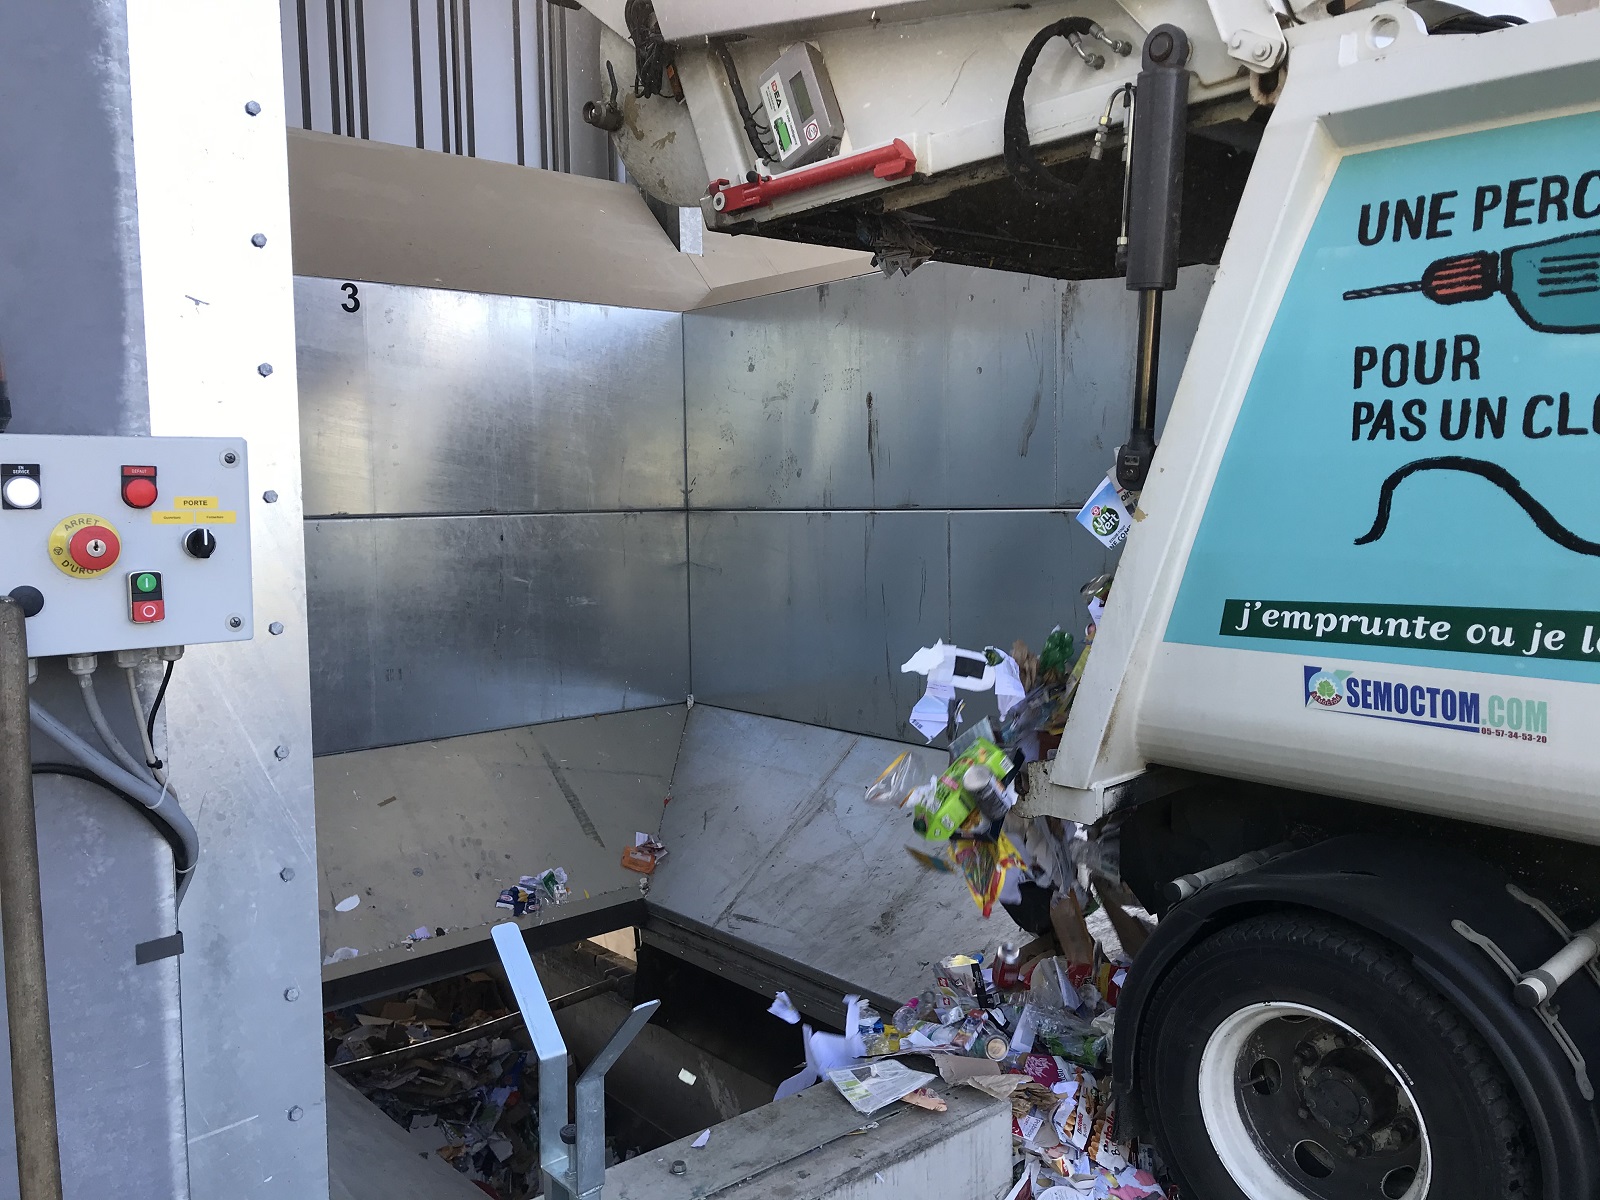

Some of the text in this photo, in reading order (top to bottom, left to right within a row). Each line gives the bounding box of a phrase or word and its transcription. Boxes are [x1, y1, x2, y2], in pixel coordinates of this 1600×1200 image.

[1358, 169, 1600, 246] UNE PERC
[340, 282, 361, 313] 3
[1353, 334, 1481, 389] POUR
[1352, 398, 1428, 442] PAS
[1439, 395, 1508, 441] UN
[63, 517, 100, 532] ARRET
[1093, 511, 1112, 528] Uni
[1096, 513, 1120, 534] Vert
[1234, 601, 1600, 656] j'emprunte ou je l
[1480, 726, 1548, 744] 05-57-34-53-20
